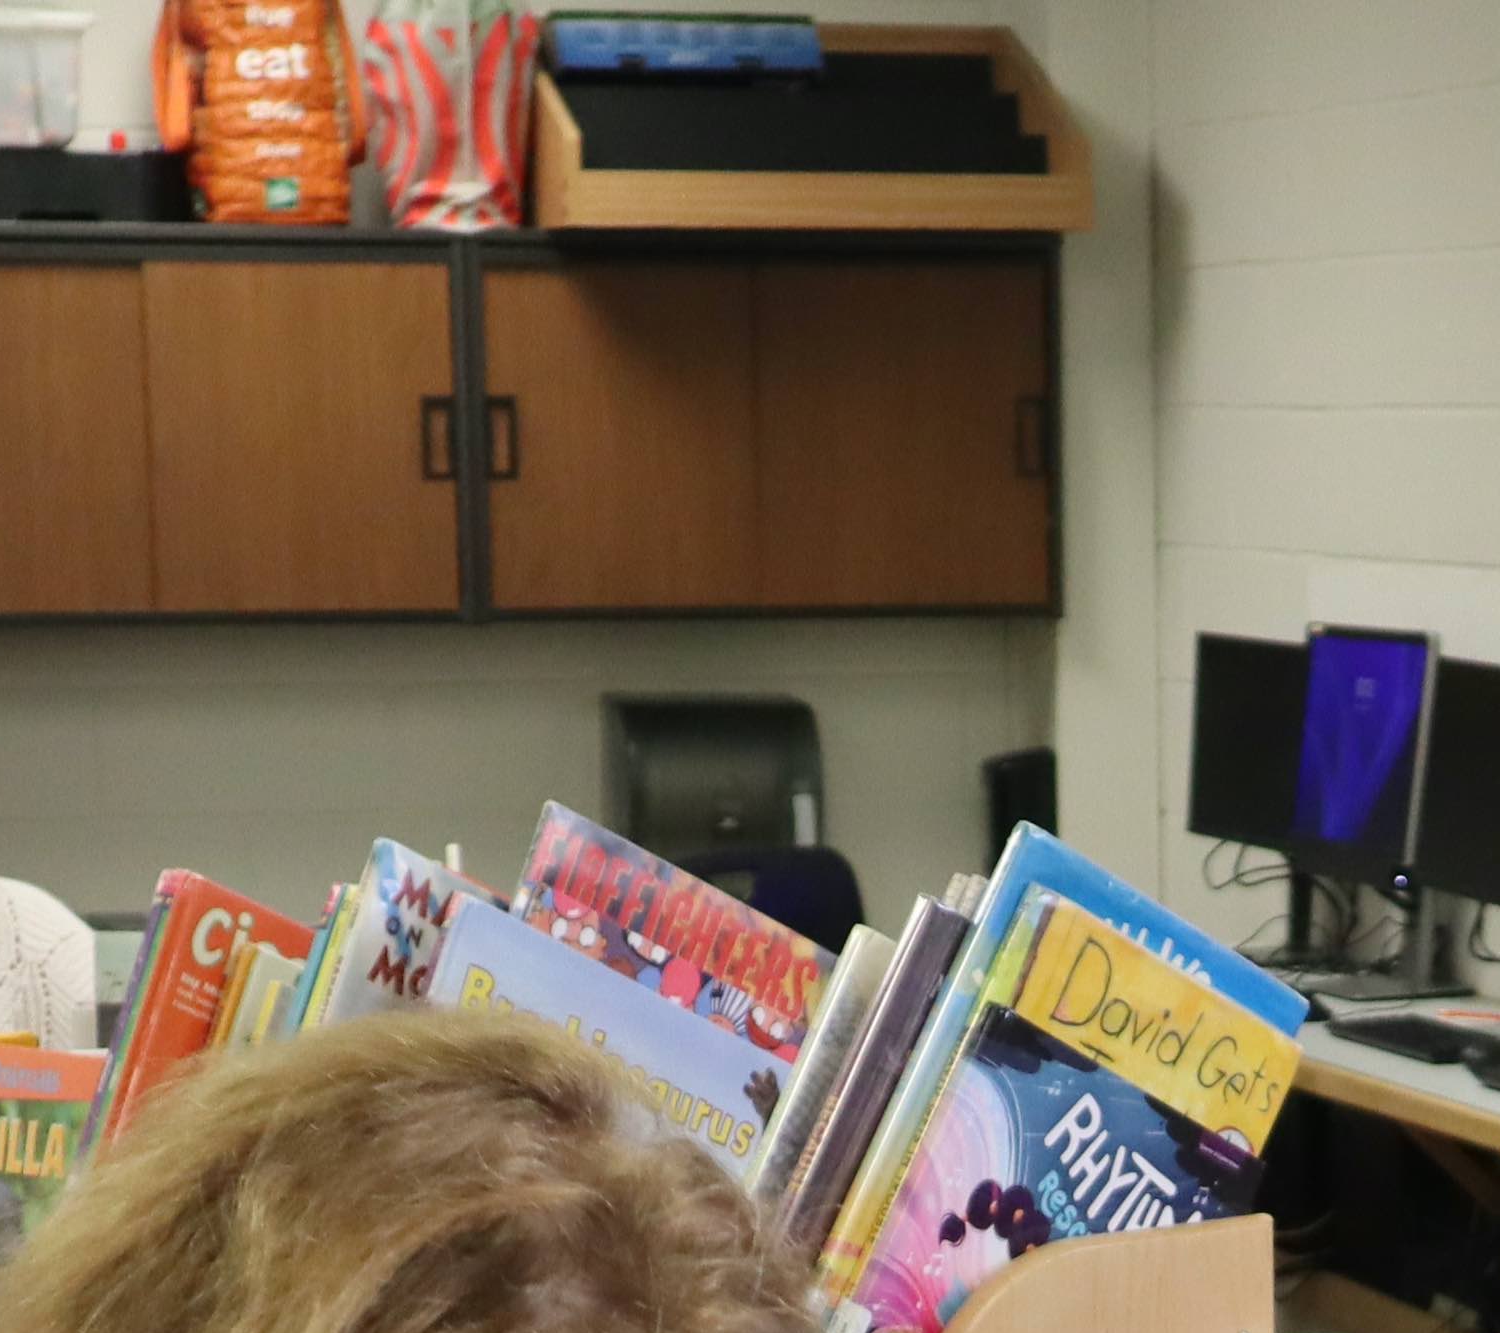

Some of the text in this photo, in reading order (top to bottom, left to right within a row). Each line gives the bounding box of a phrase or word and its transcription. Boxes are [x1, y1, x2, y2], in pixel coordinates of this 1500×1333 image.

[235, 43, 311, 79] eat
[530, 819, 819, 1020] FIREFIGHTERS
[1052, 937, 1204, 1067] David
[1197, 1036, 1278, 1113] Gets
[1044, 1092, 1203, 1232] RHYTH
